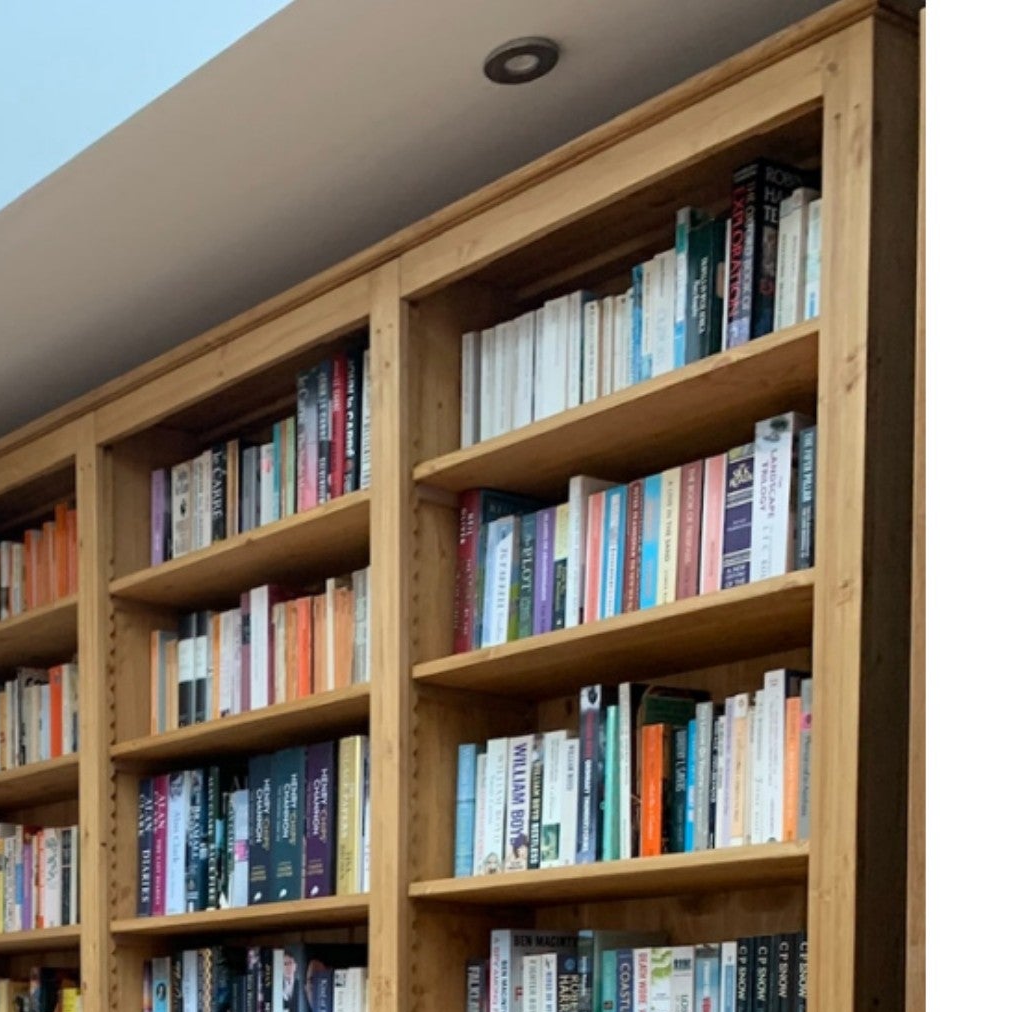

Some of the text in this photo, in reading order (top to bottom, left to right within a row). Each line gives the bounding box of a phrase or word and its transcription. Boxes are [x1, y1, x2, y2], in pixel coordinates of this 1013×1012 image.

[728, 187, 746, 319] EXPLORATION
[290, 773, 299, 809] HENRY
[320, 768, 328, 806] HENRY
[512, 743, 528, 805] WILLIAM
[263, 778, 271, 814] HENRY
[282, 782, 291, 839] CHANNON
[311, 778, 321, 836] CHANNON
[255, 787, 264, 844] CHANNON
[141, 850, 151, 904] DIARIES
[500, 960, 508, 977] BEN
[737, 966, 747, 1002] SNOW
[757, 967, 767, 1003] SNOW
[778, 963, 789, 999] SNOW
